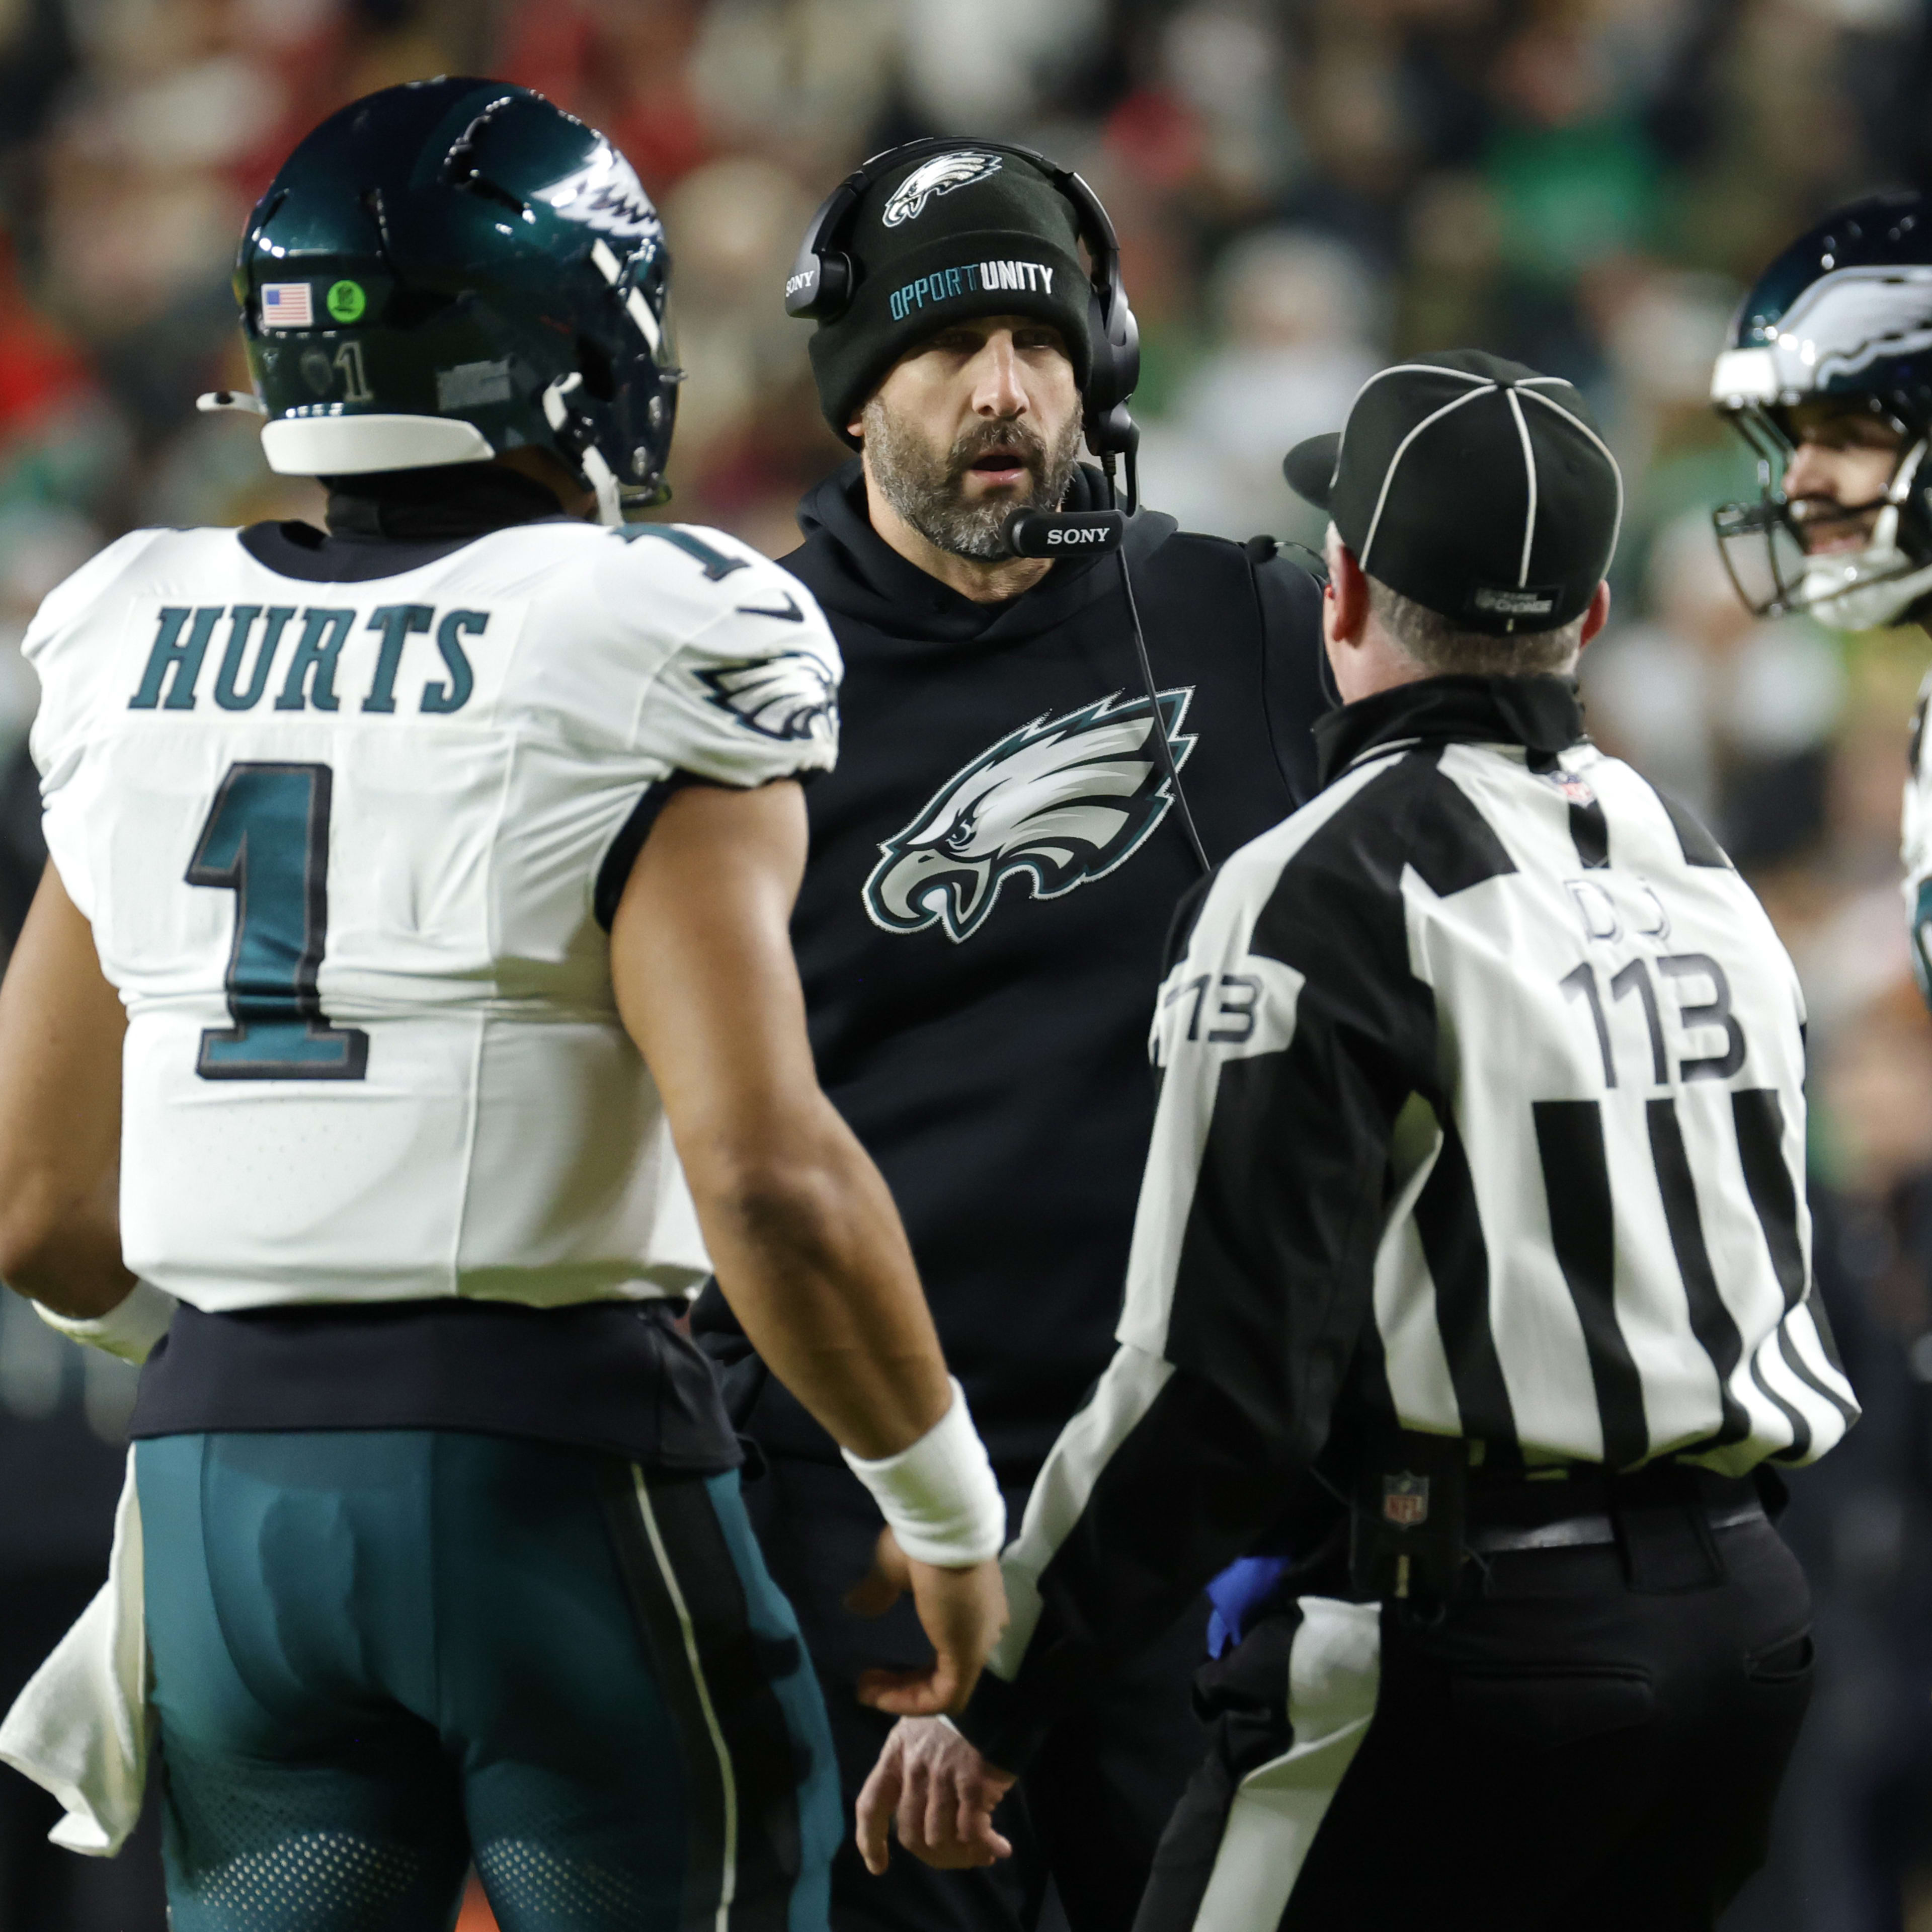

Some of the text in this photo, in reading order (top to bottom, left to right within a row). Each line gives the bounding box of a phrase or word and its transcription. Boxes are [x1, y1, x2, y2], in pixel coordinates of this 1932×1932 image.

[889, 260, 1053, 321] OPPORTUNITY
[334, 341, 374, 401] 1
[1047, 528, 1110, 544] SONY
[128, 604, 490, 713] HURTS
[183, 760, 370, 1080] 1
[1559, 952, 1746, 1089] 113
